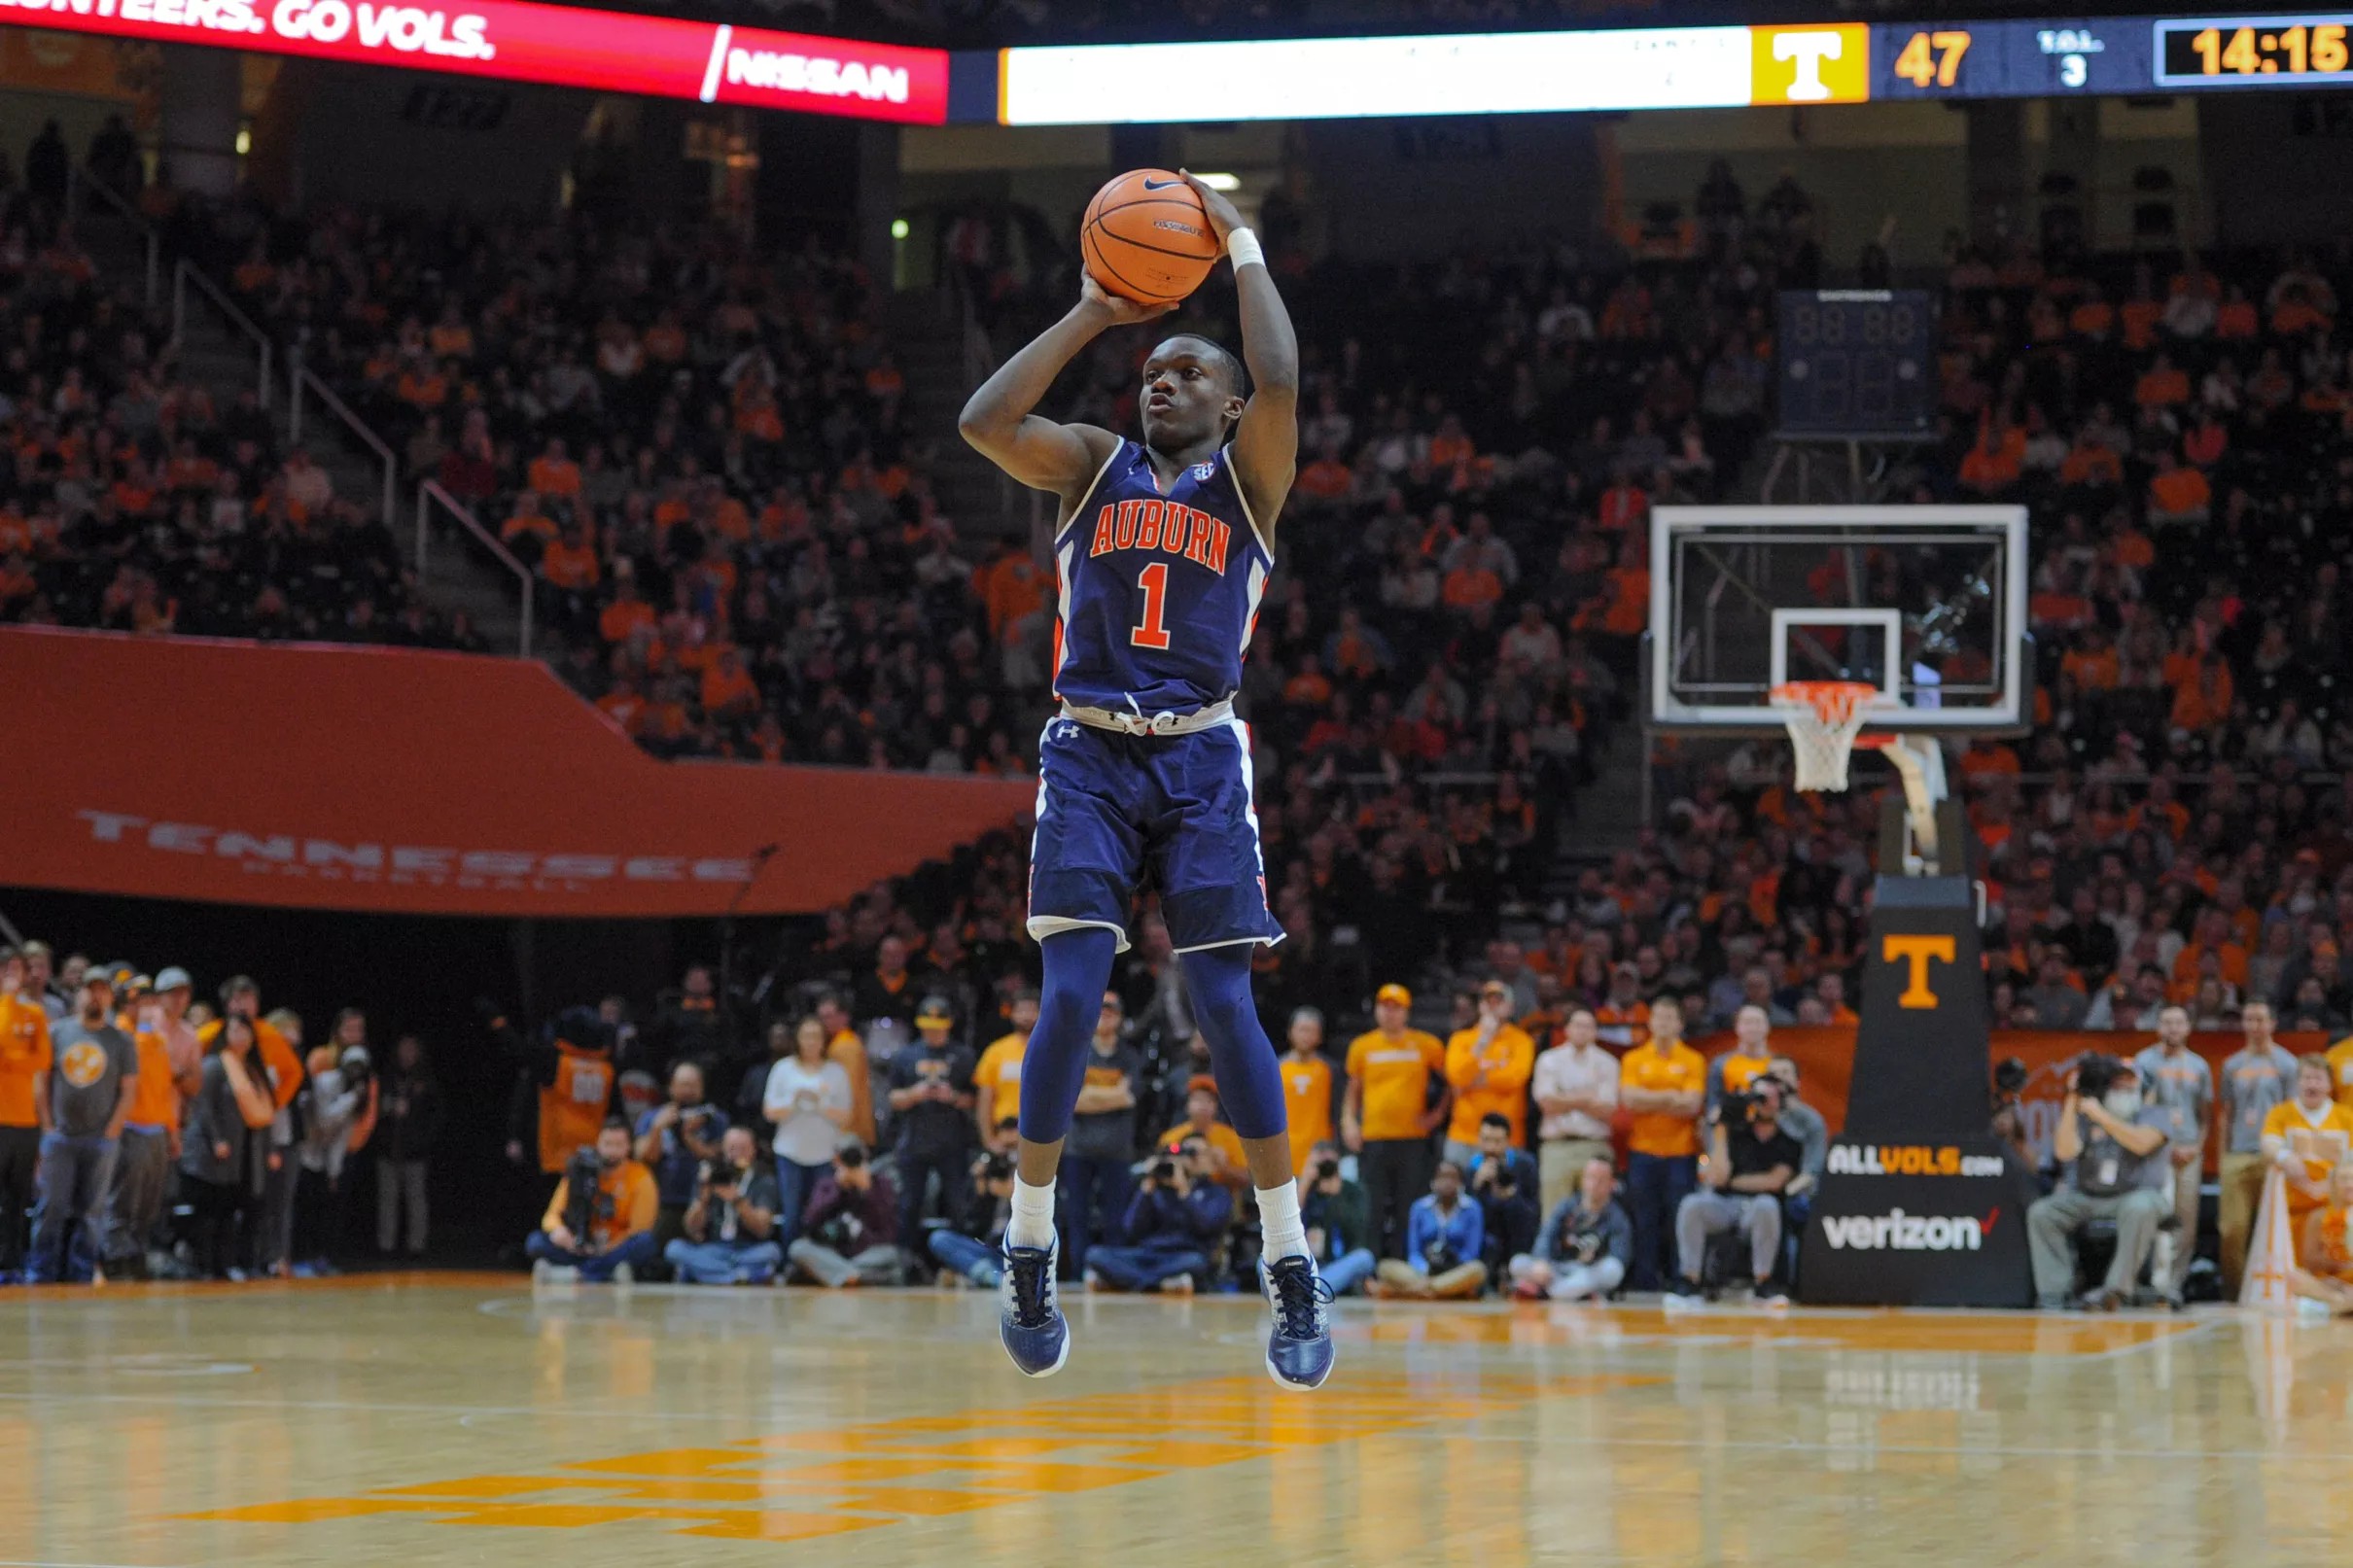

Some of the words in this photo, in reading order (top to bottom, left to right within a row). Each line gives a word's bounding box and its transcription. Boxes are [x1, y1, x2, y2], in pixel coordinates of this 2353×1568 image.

[272, 0, 351, 42] GO
[357, 3, 496, 60] VOLS.
[1895, 31, 1972, 87] 47
[2192, 24, 2349, 76] 14:15
[727, 48, 909, 103] NISSAN
[1773, 31, 1843, 100] T
[2060, 53, 2088, 87] 3
[1090, 499, 1231, 576] AUBURN
[1130, 562, 1171, 649] 1
[75, 809, 755, 882] TENNESSEE
[1882, 934, 1956, 1009] T
[1821, 1206, 1982, 1251] verizon
